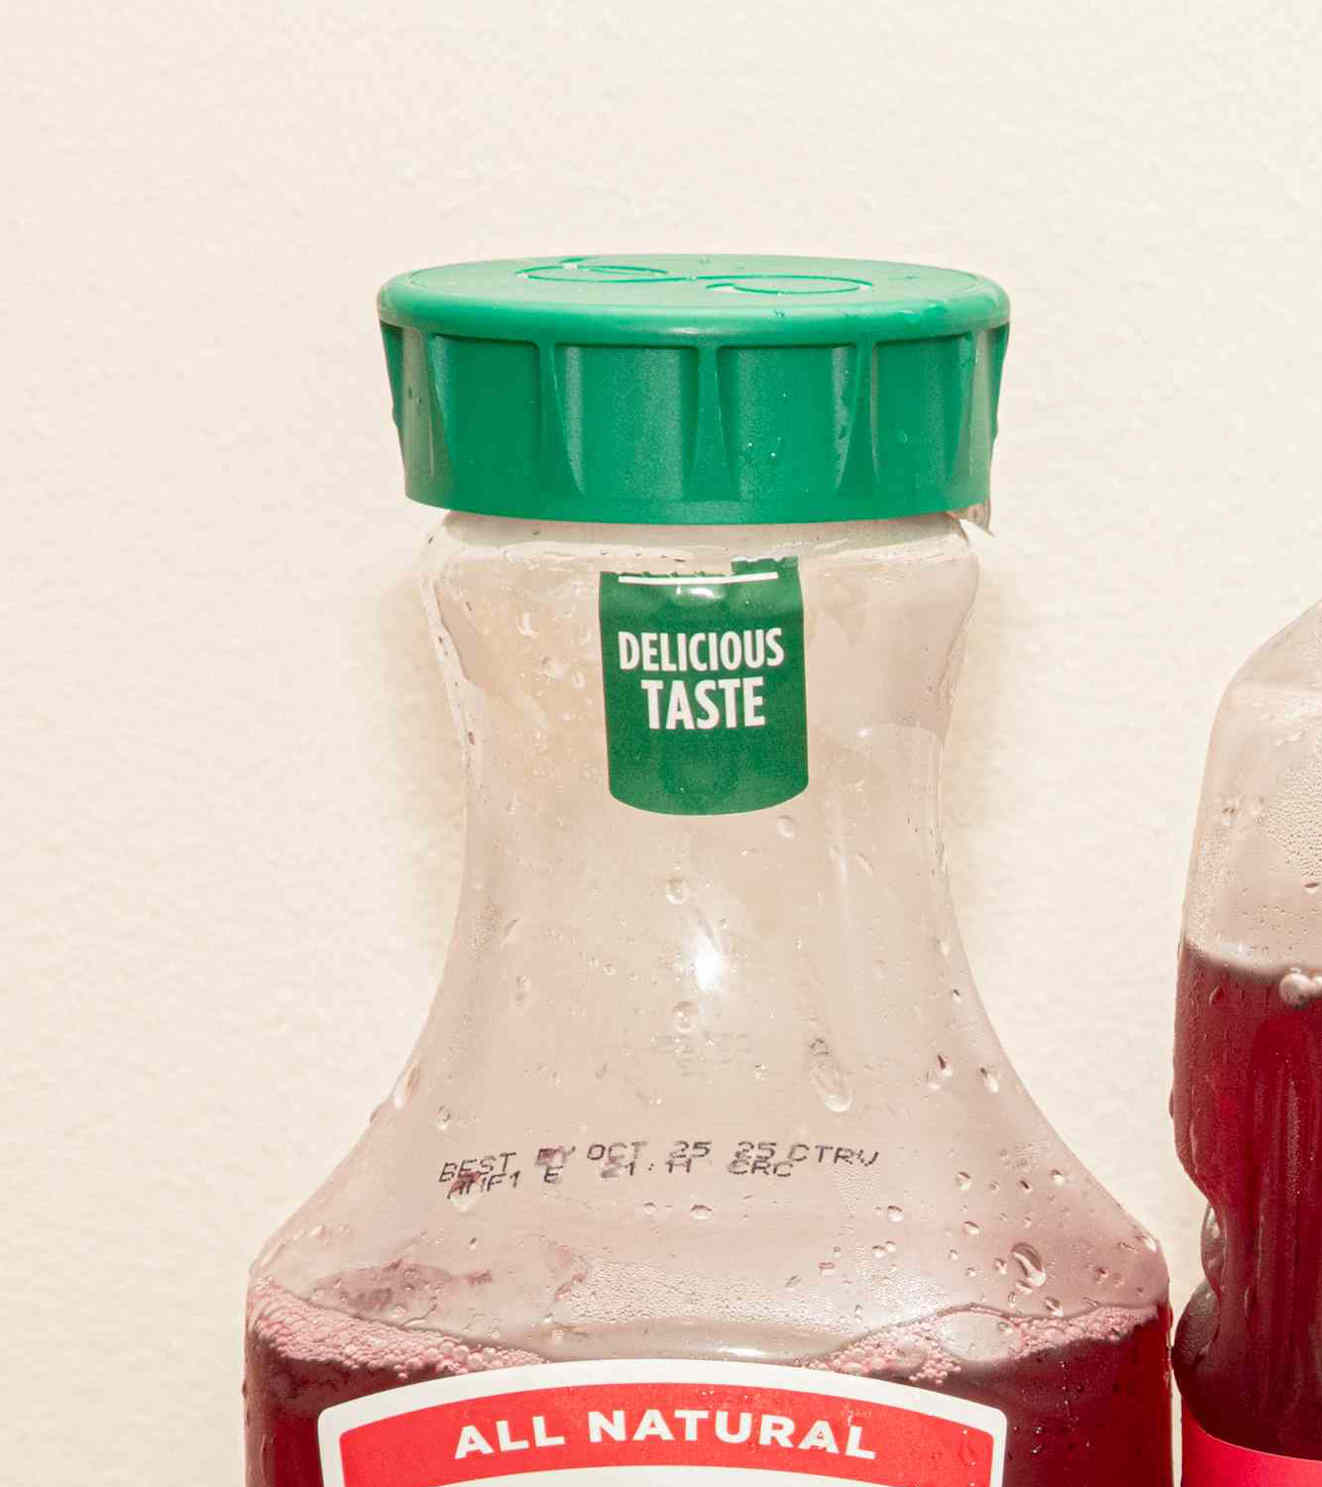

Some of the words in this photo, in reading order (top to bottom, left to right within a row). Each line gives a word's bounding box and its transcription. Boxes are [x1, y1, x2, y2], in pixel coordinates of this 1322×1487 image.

[618, 628, 784, 671] DELICIOUS
[641, 677, 766, 730] TASTE
[438, 1152, 517, 1183] BEST
[586, 1141, 647, 1161] OCT
[670, 1141, 712, 1159] 25
[734, 1141, 776, 1160] 25
[454, 1415, 566, 1460] ALL
[587, 1409, 878, 1460] NATURAL
